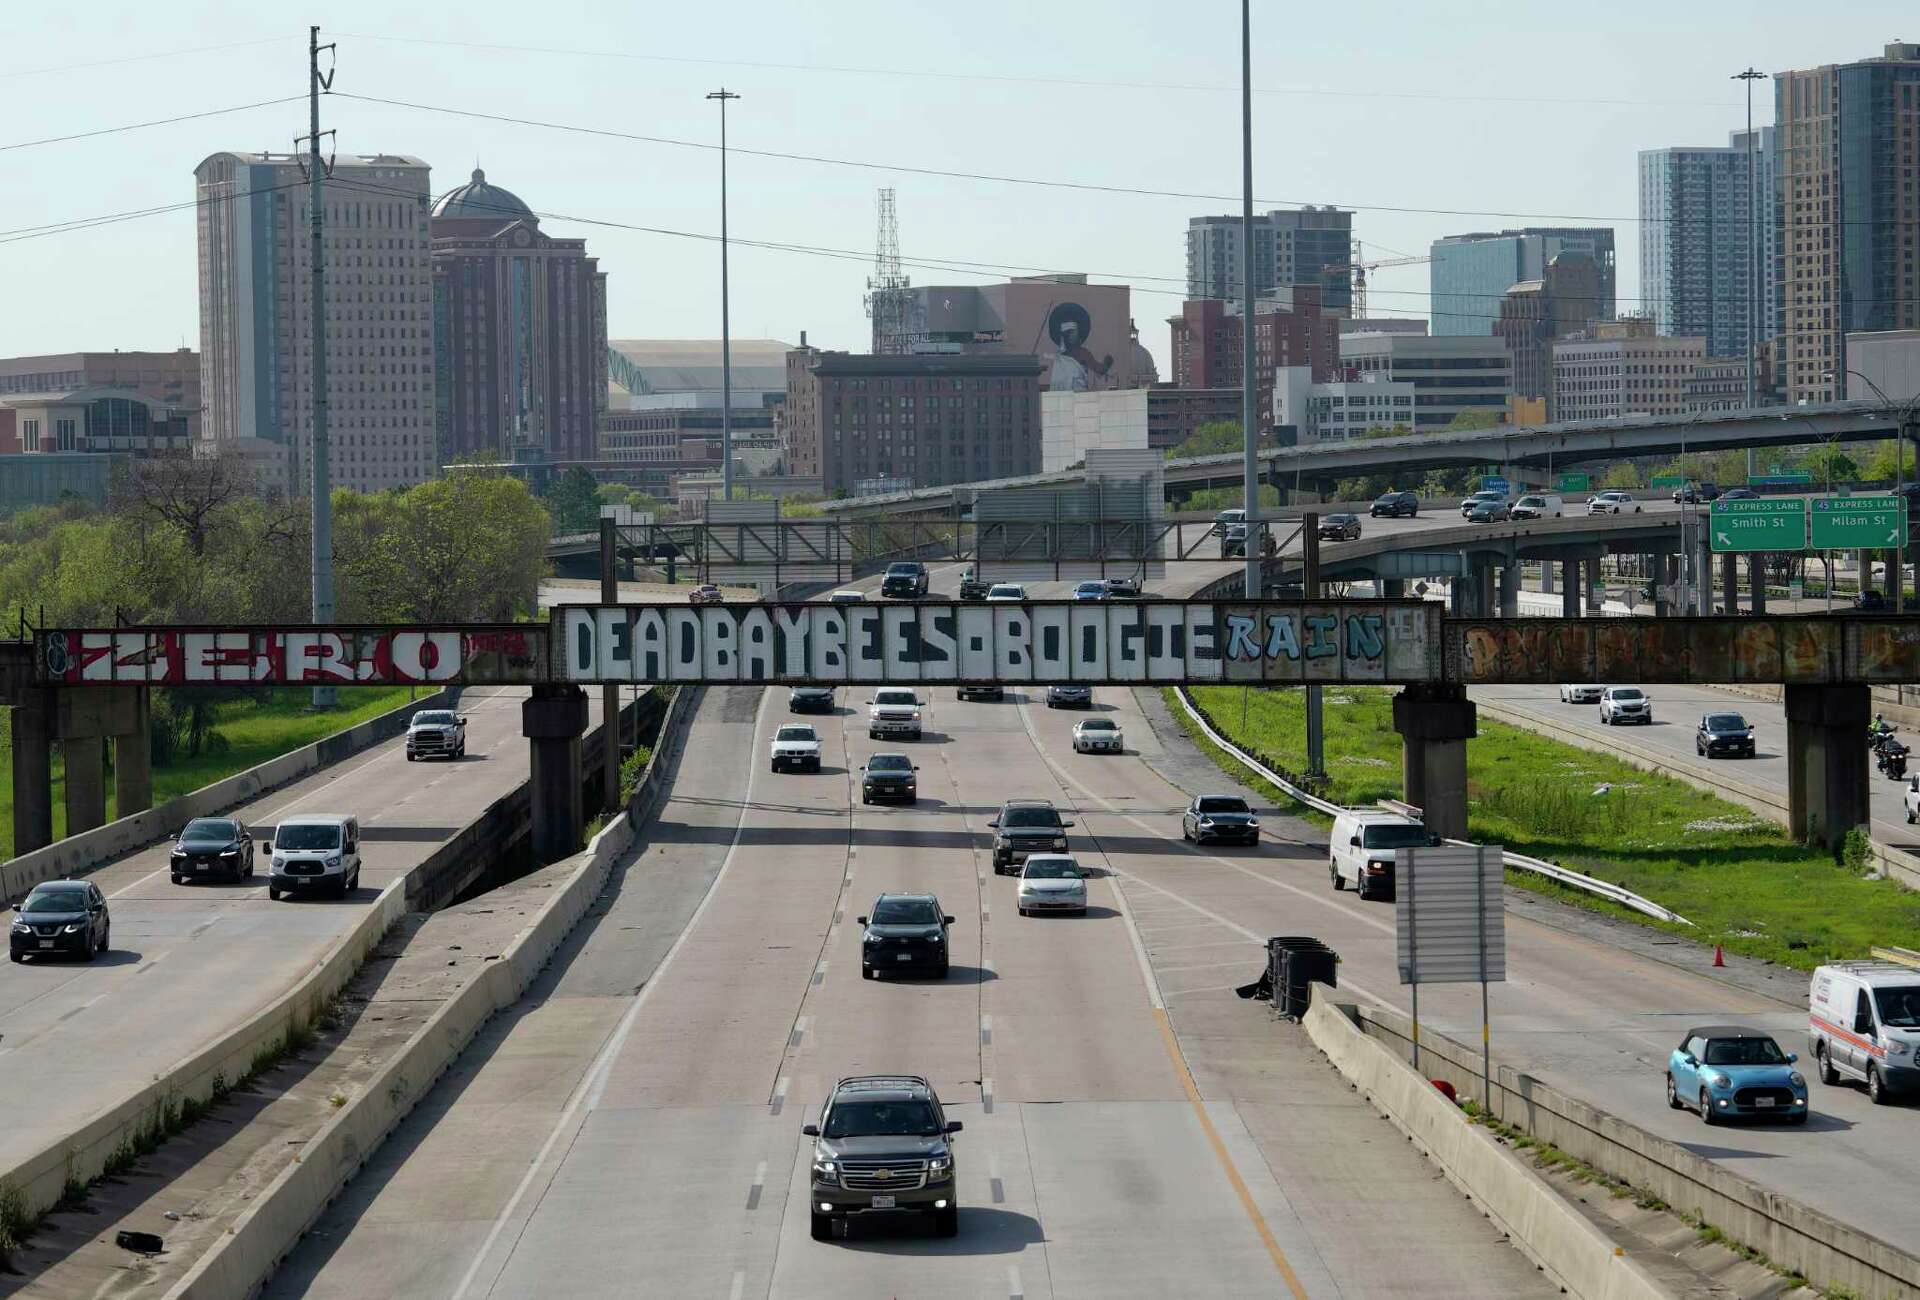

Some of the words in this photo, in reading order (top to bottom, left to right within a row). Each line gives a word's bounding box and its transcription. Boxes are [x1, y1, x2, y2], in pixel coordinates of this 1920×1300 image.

[1718, 502, 1729, 511] 45
[1733, 503, 1772, 511] EXPRESS
[1776, 502, 1800, 510] LANE
[1818, 501, 1829, 510] 45
[1834, 500, 1873, 509] EXPRESS
[1731, 518, 1767, 528] Smith
[1772, 517, 1785, 527] St
[1831, 516, 1868, 526] Milam
[1873, 515, 1886, 525] St
[1226, 614, 1384, 661] RAIN
[79, 632, 462, 682] ZERO
